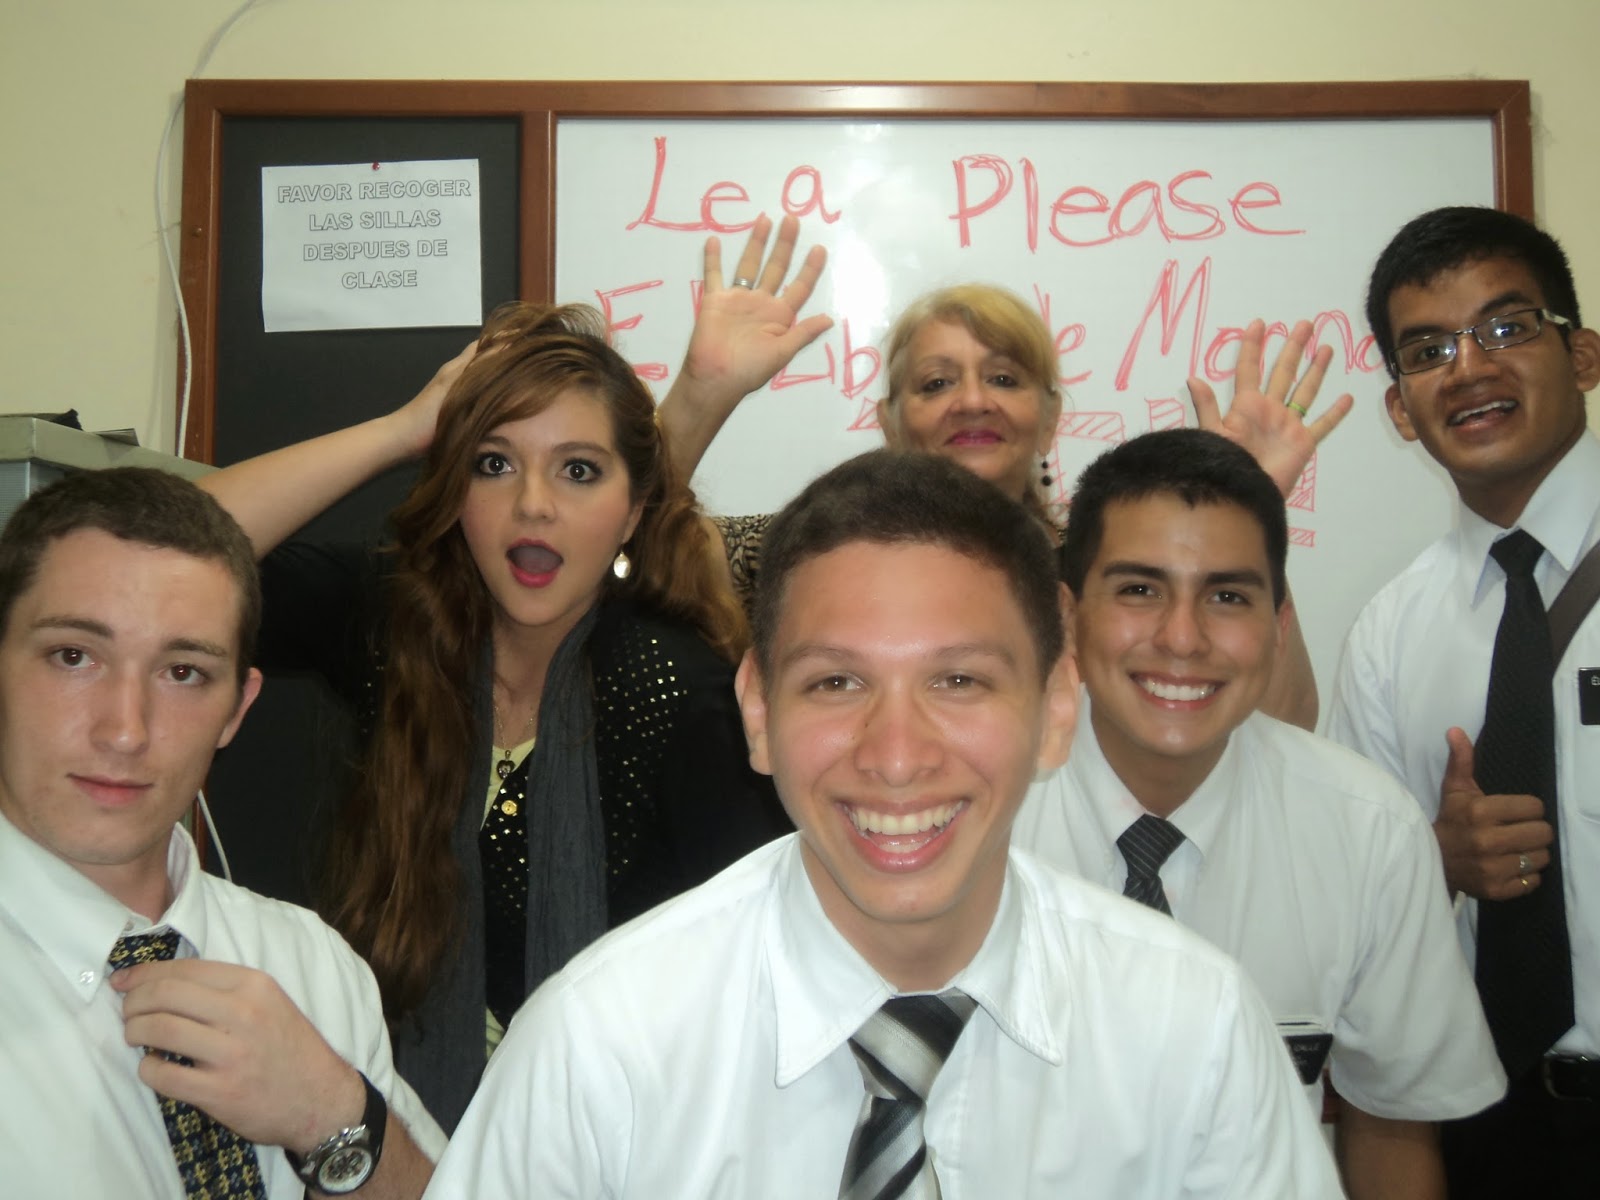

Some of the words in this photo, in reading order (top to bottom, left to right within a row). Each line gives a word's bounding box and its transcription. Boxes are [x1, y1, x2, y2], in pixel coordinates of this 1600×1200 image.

[277, 183, 352, 203] FAVOR
[358, 179, 472, 199] RECOGER
[625, 136, 842, 233] Lea
[949, 153, 1306, 254] Please
[309, 213, 353, 231] LAS
[359, 209, 441, 229] SILLAS
[303, 241, 410, 261] DESPUES
[417, 239, 448, 257] DE
[341, 270, 418, 289] CLASE
